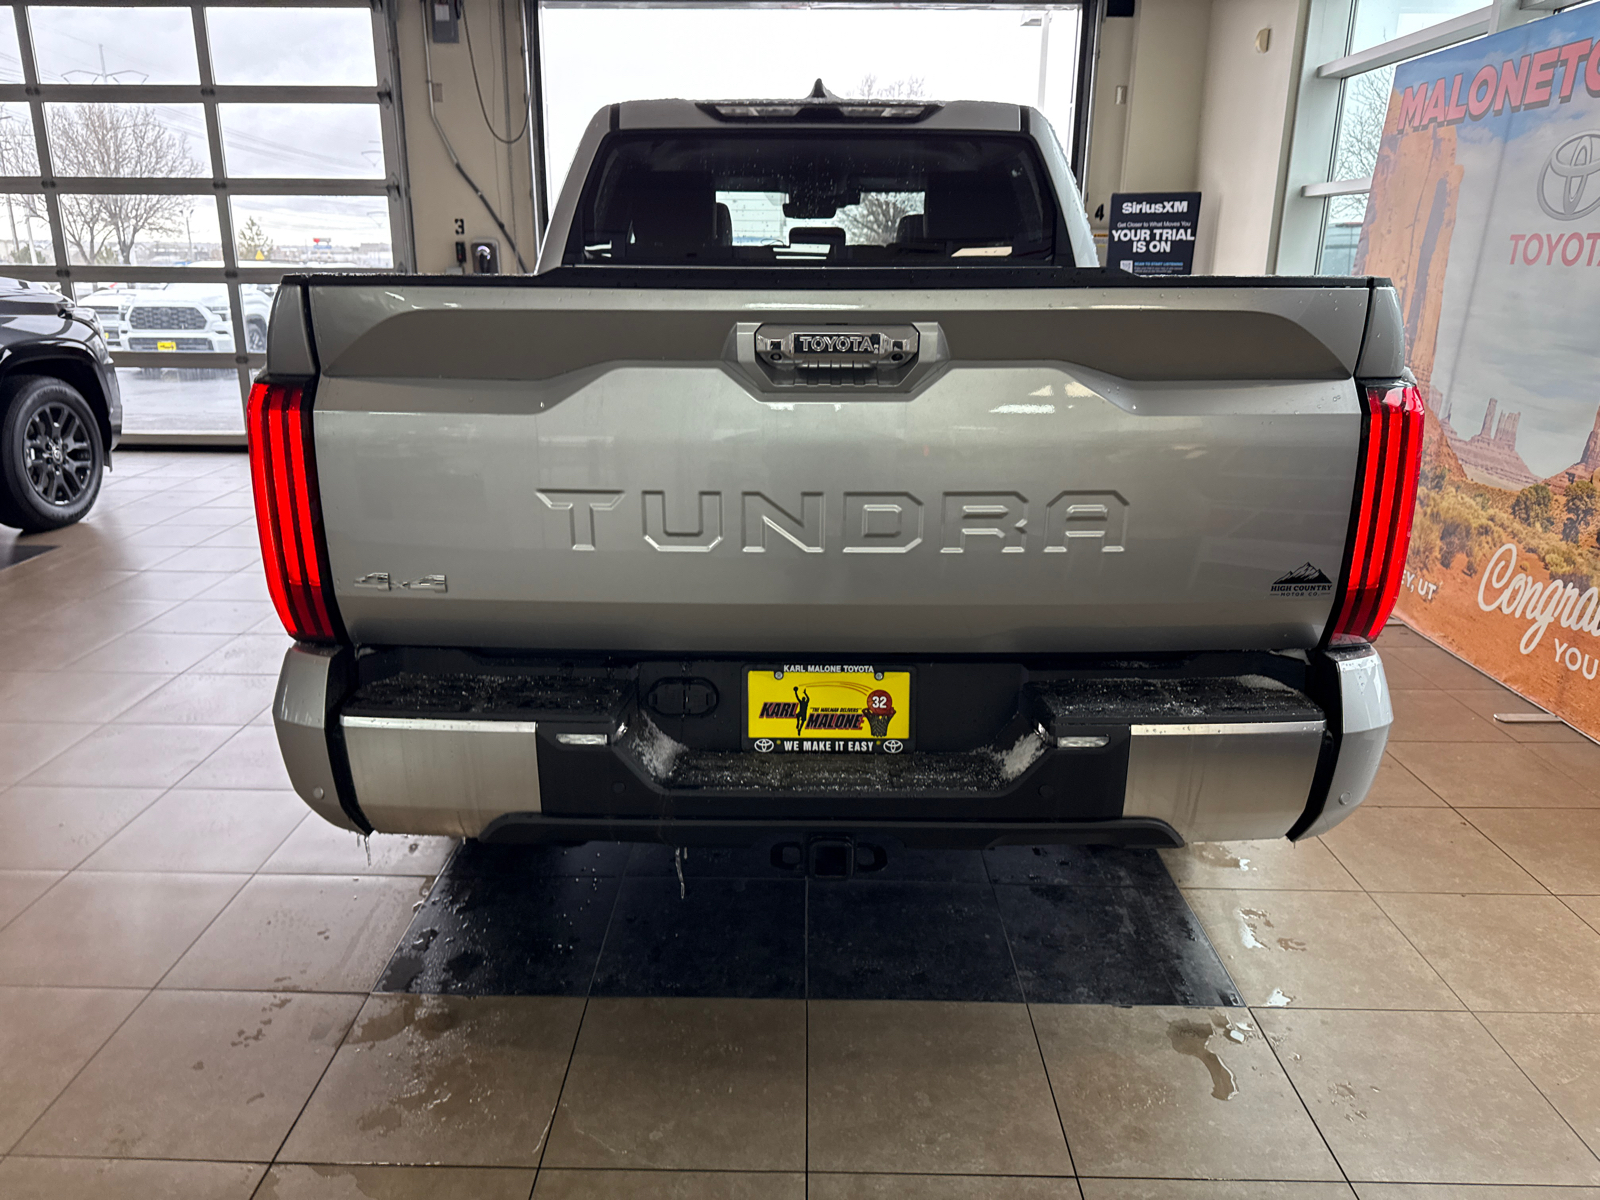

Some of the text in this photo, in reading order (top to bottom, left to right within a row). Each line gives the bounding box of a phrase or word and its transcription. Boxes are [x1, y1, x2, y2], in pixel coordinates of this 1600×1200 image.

[1095, 204, 1104, 221] 4
[1122, 201, 1188, 214] SiriusXM
[454, 218, 465, 235] 3
[1112, 229, 1150, 241] YOUR
[1153, 228, 1195, 241] TRIAL
[1132, 241, 1171, 253] IS ON
[1509, 232, 1600, 267] TOYOT
[799, 336, 873, 352] TOYOTA
[535, 488, 1130, 553] TUNDRA
[1293, 584, 1332, 592] COUNTRY
[1417, 578, 1437, 600] UT
[784, 665, 874, 673] KARL MALONE TOYOTA
[759, 702, 799, 718] KARL
[872, 696, 887, 709] 32
[805, 713, 865, 730] MALONE
[784, 740, 874, 752] WE MAKE IT EASY
